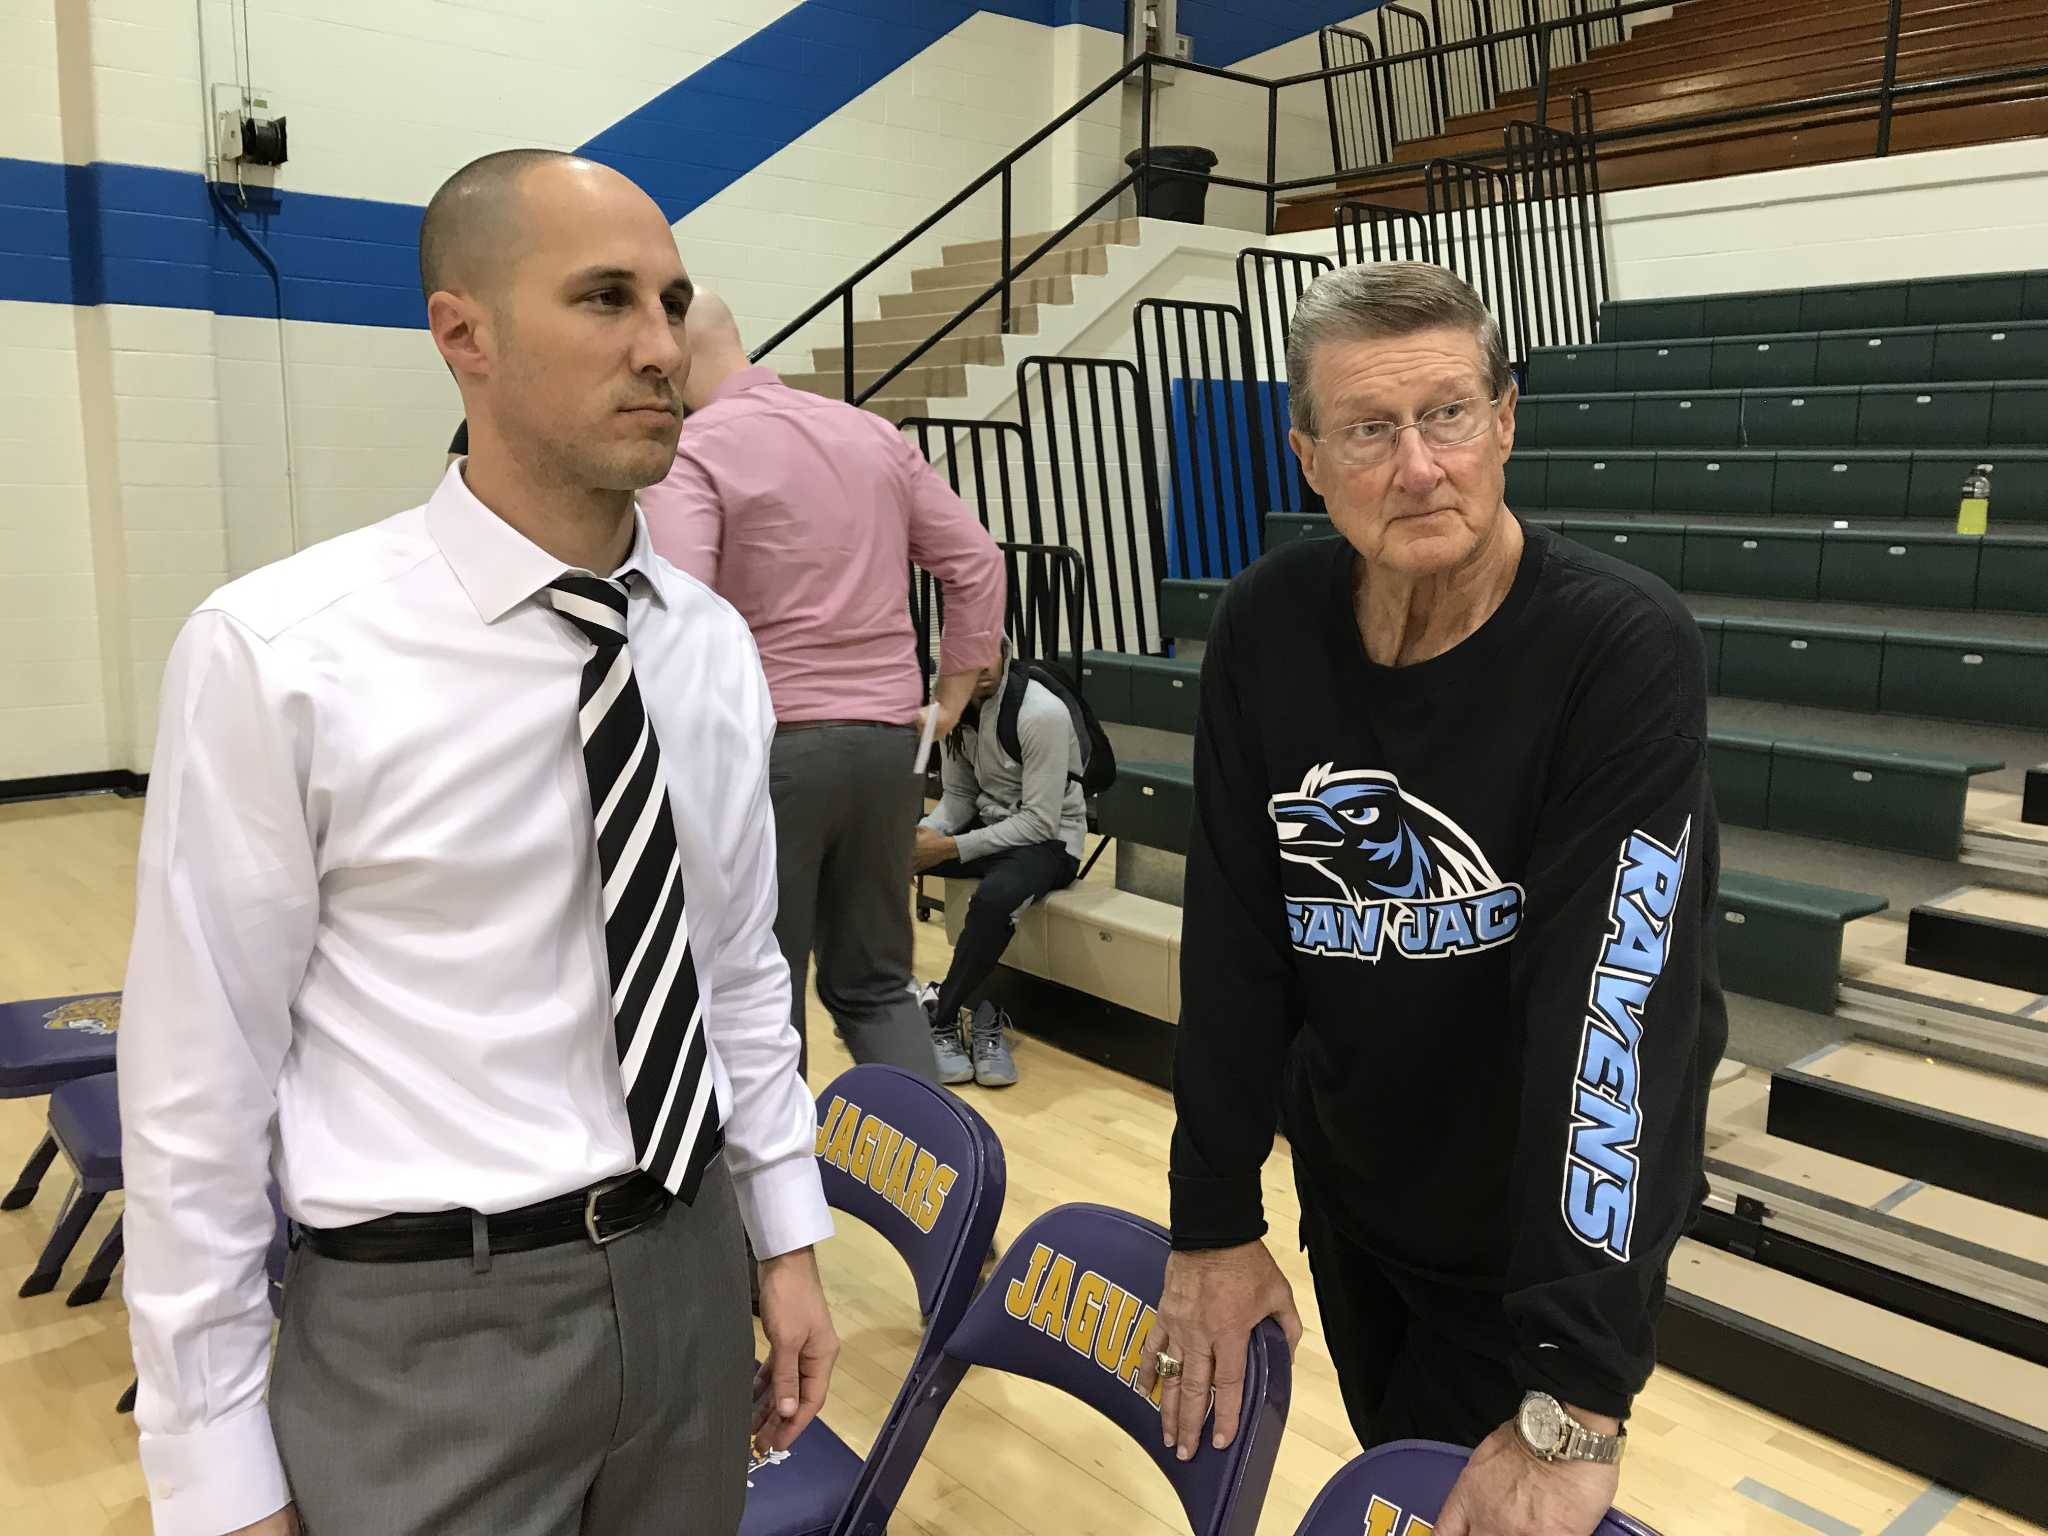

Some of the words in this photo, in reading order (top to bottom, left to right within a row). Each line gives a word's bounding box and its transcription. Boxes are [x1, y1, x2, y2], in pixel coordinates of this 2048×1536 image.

[1285, 897, 1384, 960] SAN
[1396, 884, 1525, 959] JAC
[1562, 814, 1691, 1263] RAVENS
[815, 1095, 958, 1234] JAGUARS
[1004, 1242, 1176, 1413] JAGUA
